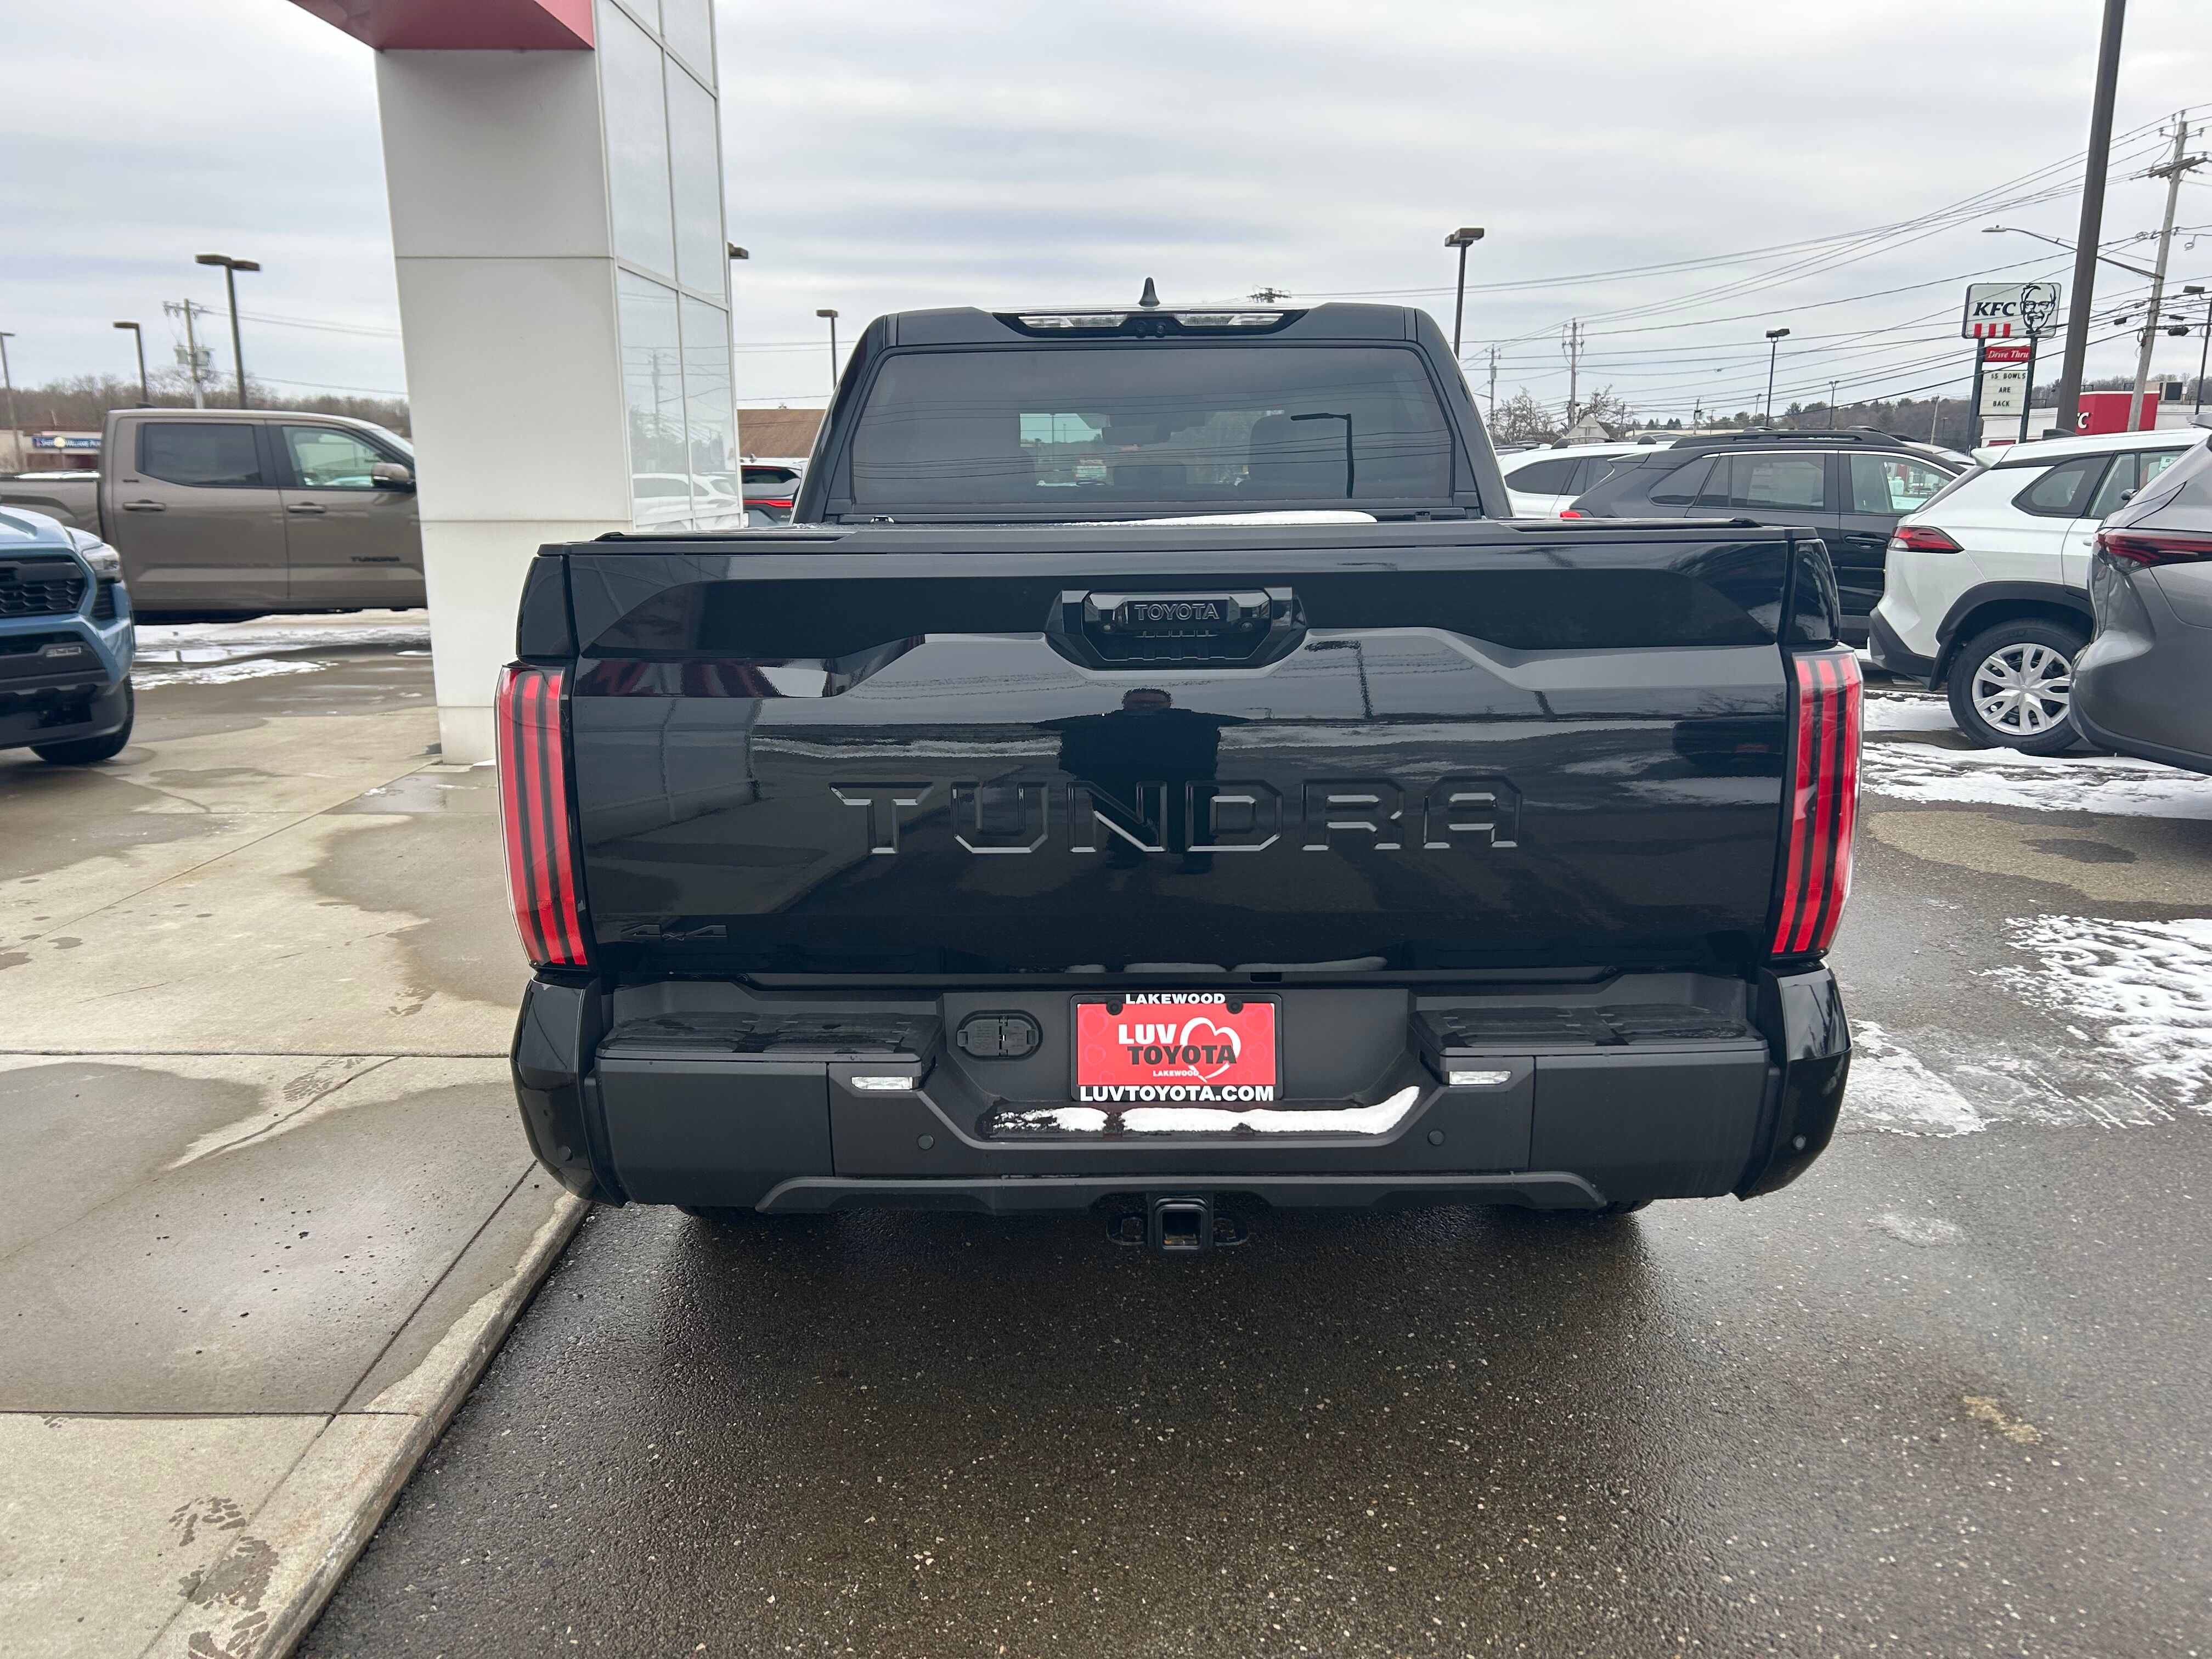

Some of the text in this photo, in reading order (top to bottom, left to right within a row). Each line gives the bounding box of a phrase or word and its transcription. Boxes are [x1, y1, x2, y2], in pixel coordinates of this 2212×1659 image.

[1973, 302, 2017, 317] KFC
[1988, 350, 2029, 358] Drive Thru
[1134, 603, 1220, 620] TOYOTA
[827, 775, 1522, 854] TUNDRA
[1125, 993, 1226, 1005] LAKEWOOD
[1118, 1024, 1177, 1045] LUV
[1127, 1045, 1237, 1065] TOYOTA
[1080, 1085, 1274, 1102] LUVTOYOTA.COM
